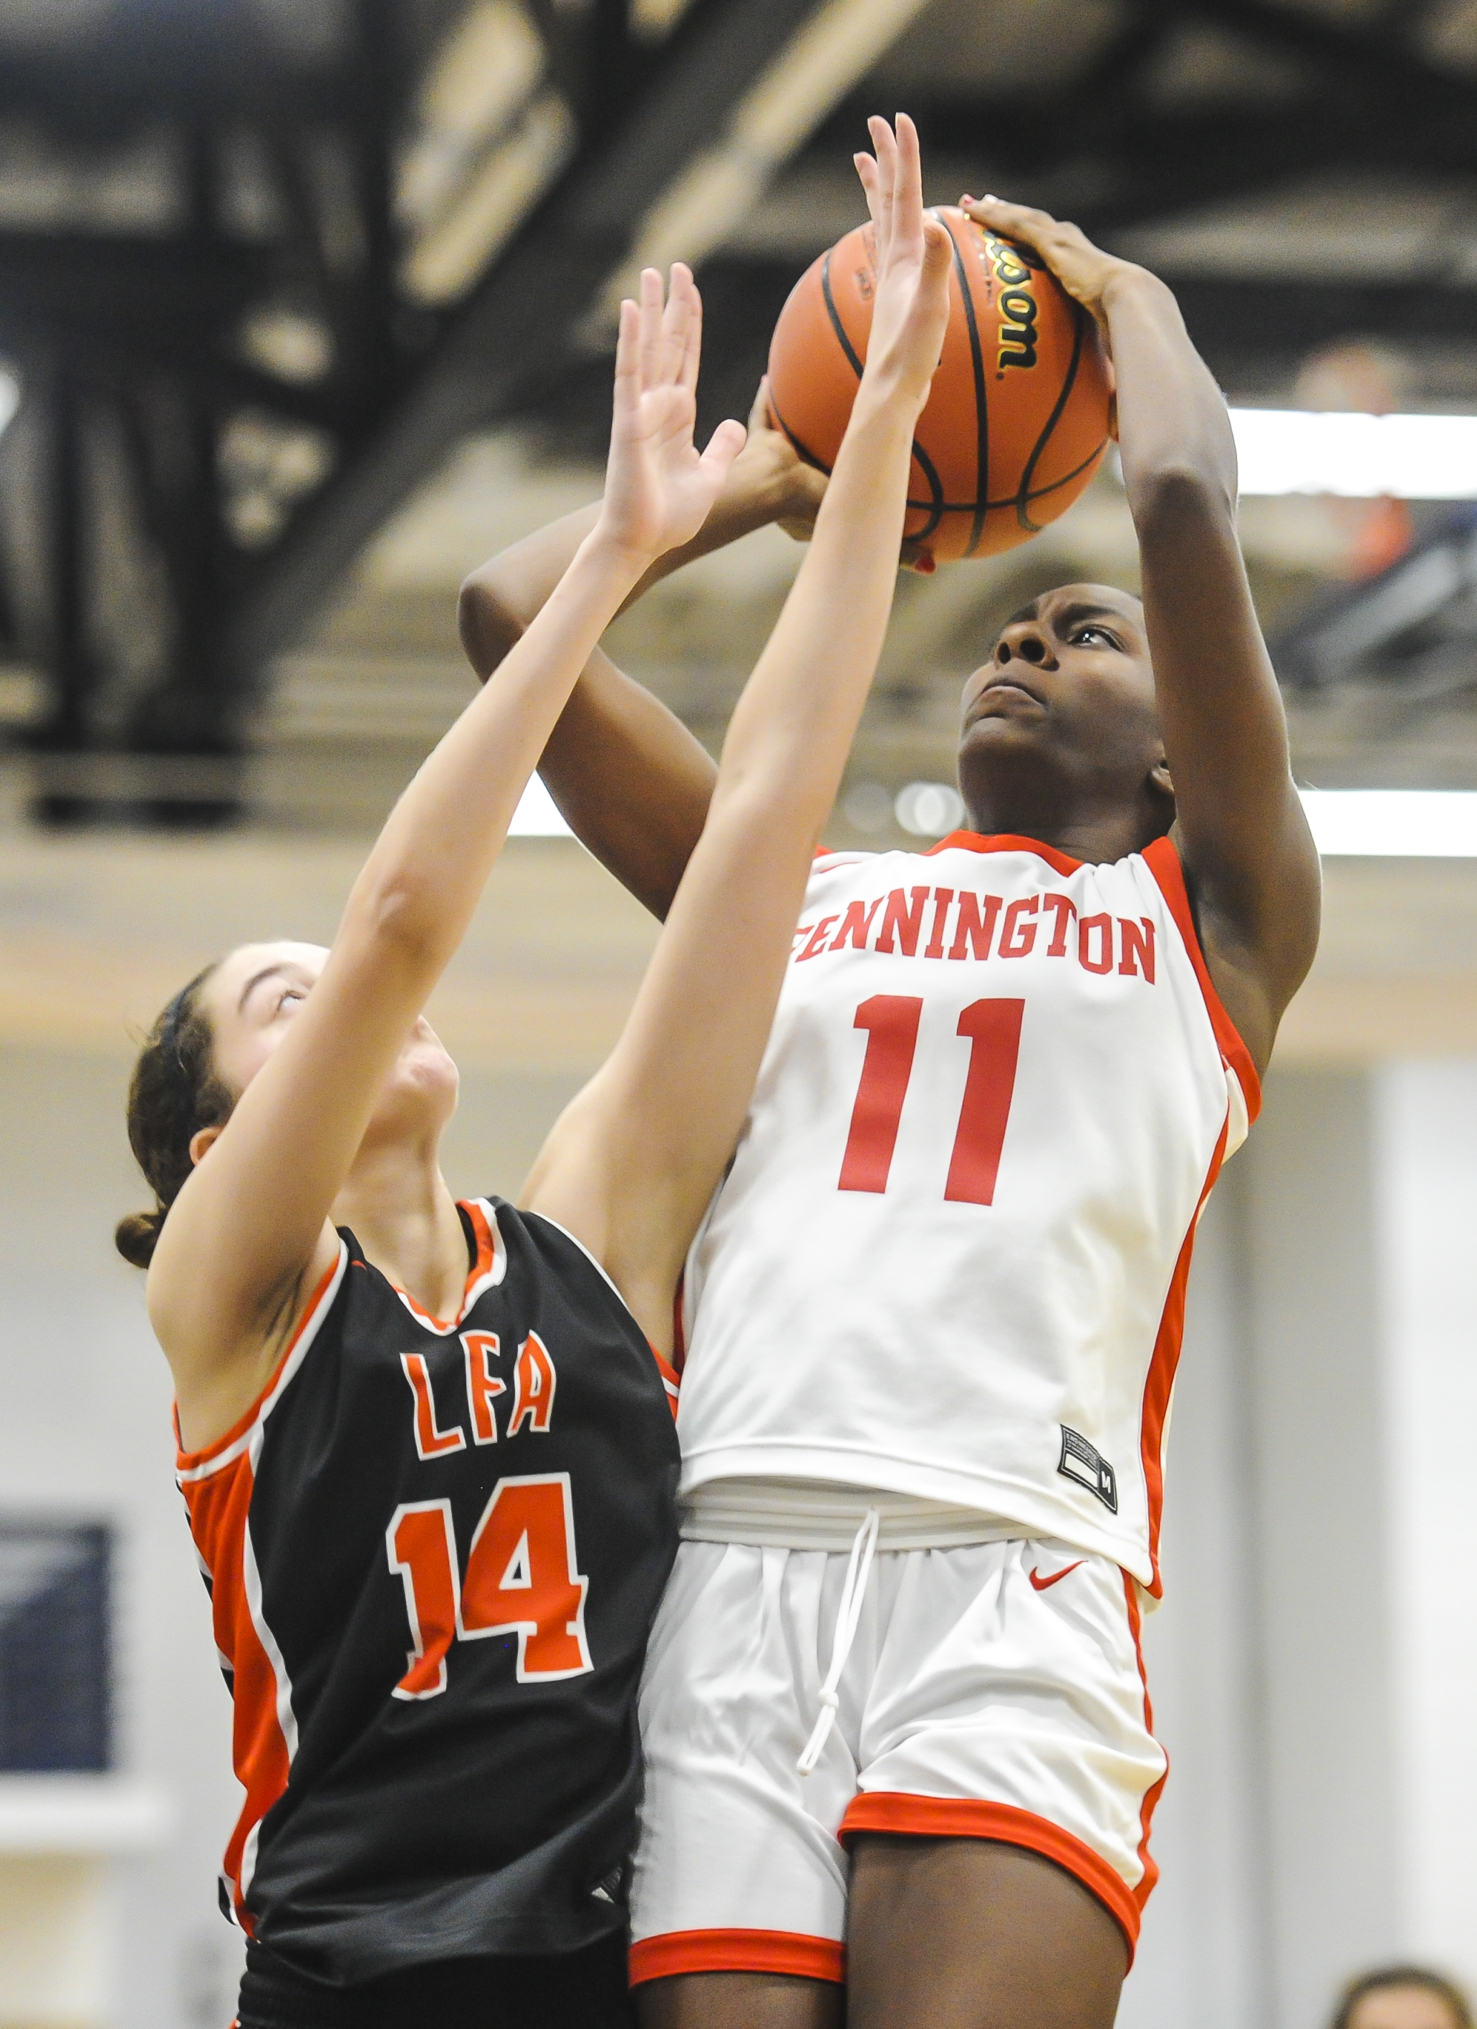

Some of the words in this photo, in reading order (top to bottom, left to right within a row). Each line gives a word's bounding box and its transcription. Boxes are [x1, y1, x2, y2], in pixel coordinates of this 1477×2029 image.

[981, 226, 1038, 370] son
[837, 994, 1026, 1207] 11
[399, 1329, 557, 1461] LFA
[385, 1471, 595, 1701] 14
